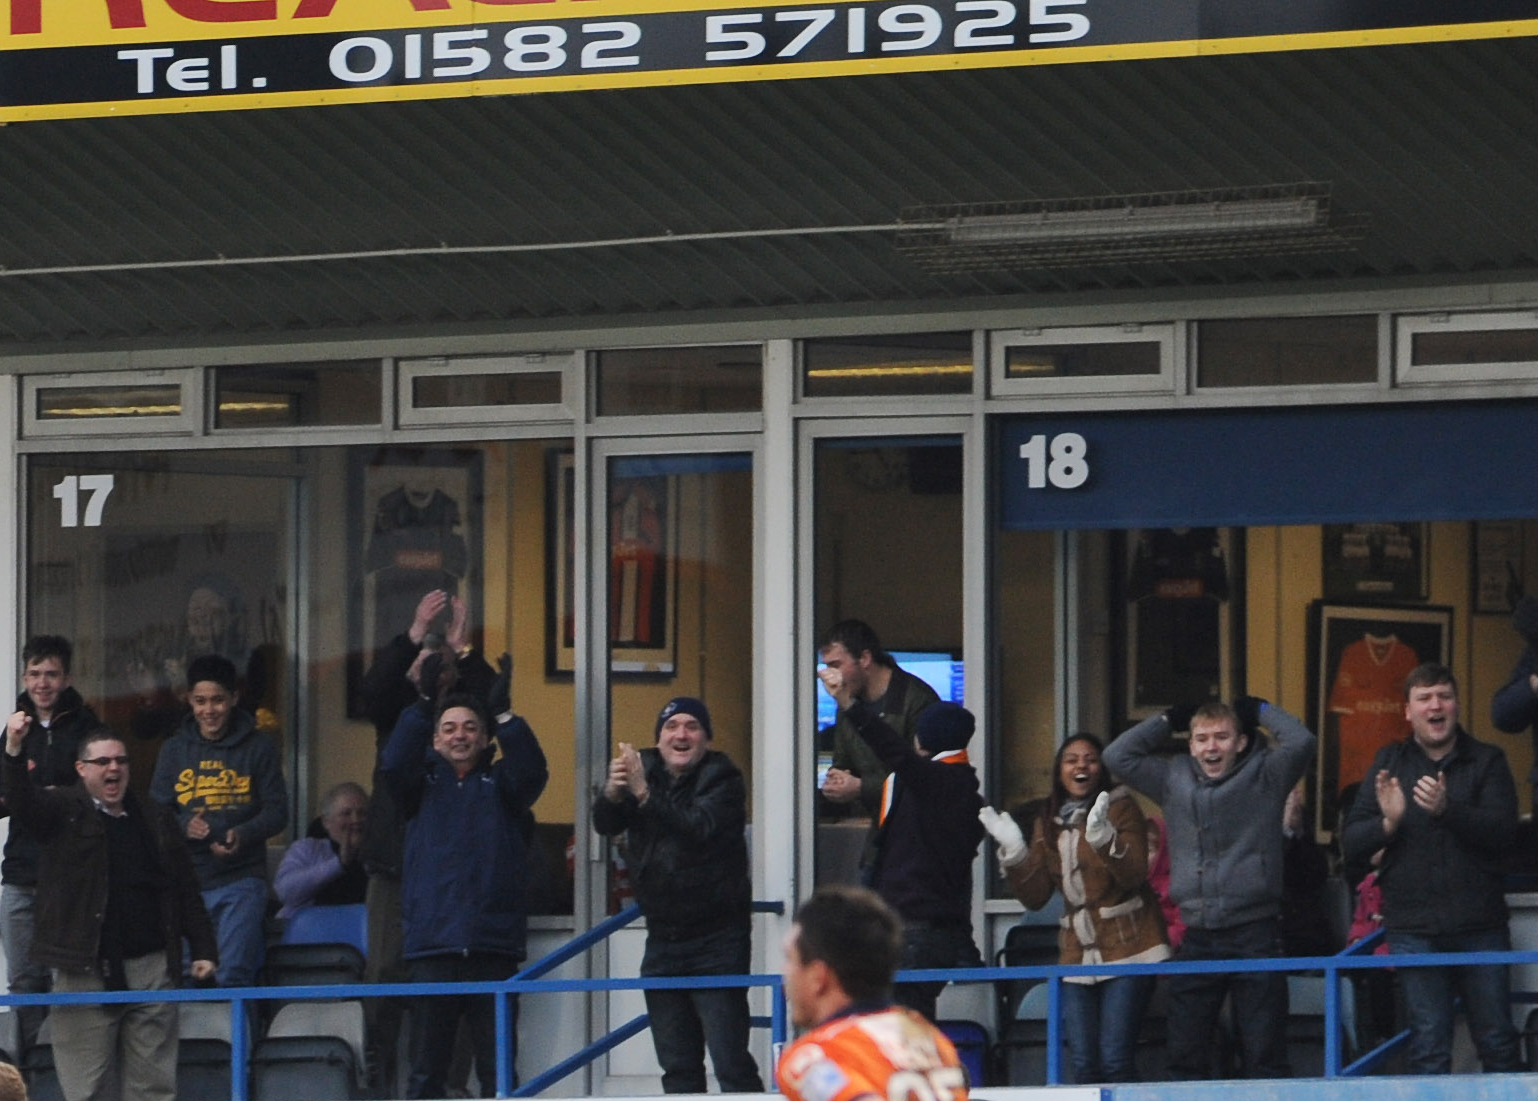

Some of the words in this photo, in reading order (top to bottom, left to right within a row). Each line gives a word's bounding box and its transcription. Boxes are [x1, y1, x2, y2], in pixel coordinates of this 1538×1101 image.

[117, 46, 266, 94] Tel.
[328, 22, 642, 83] 01582
[704, 0, 1092, 62] 571925
[1019, 432, 1089, 488] 18
[53, 474, 114, 527] 17
